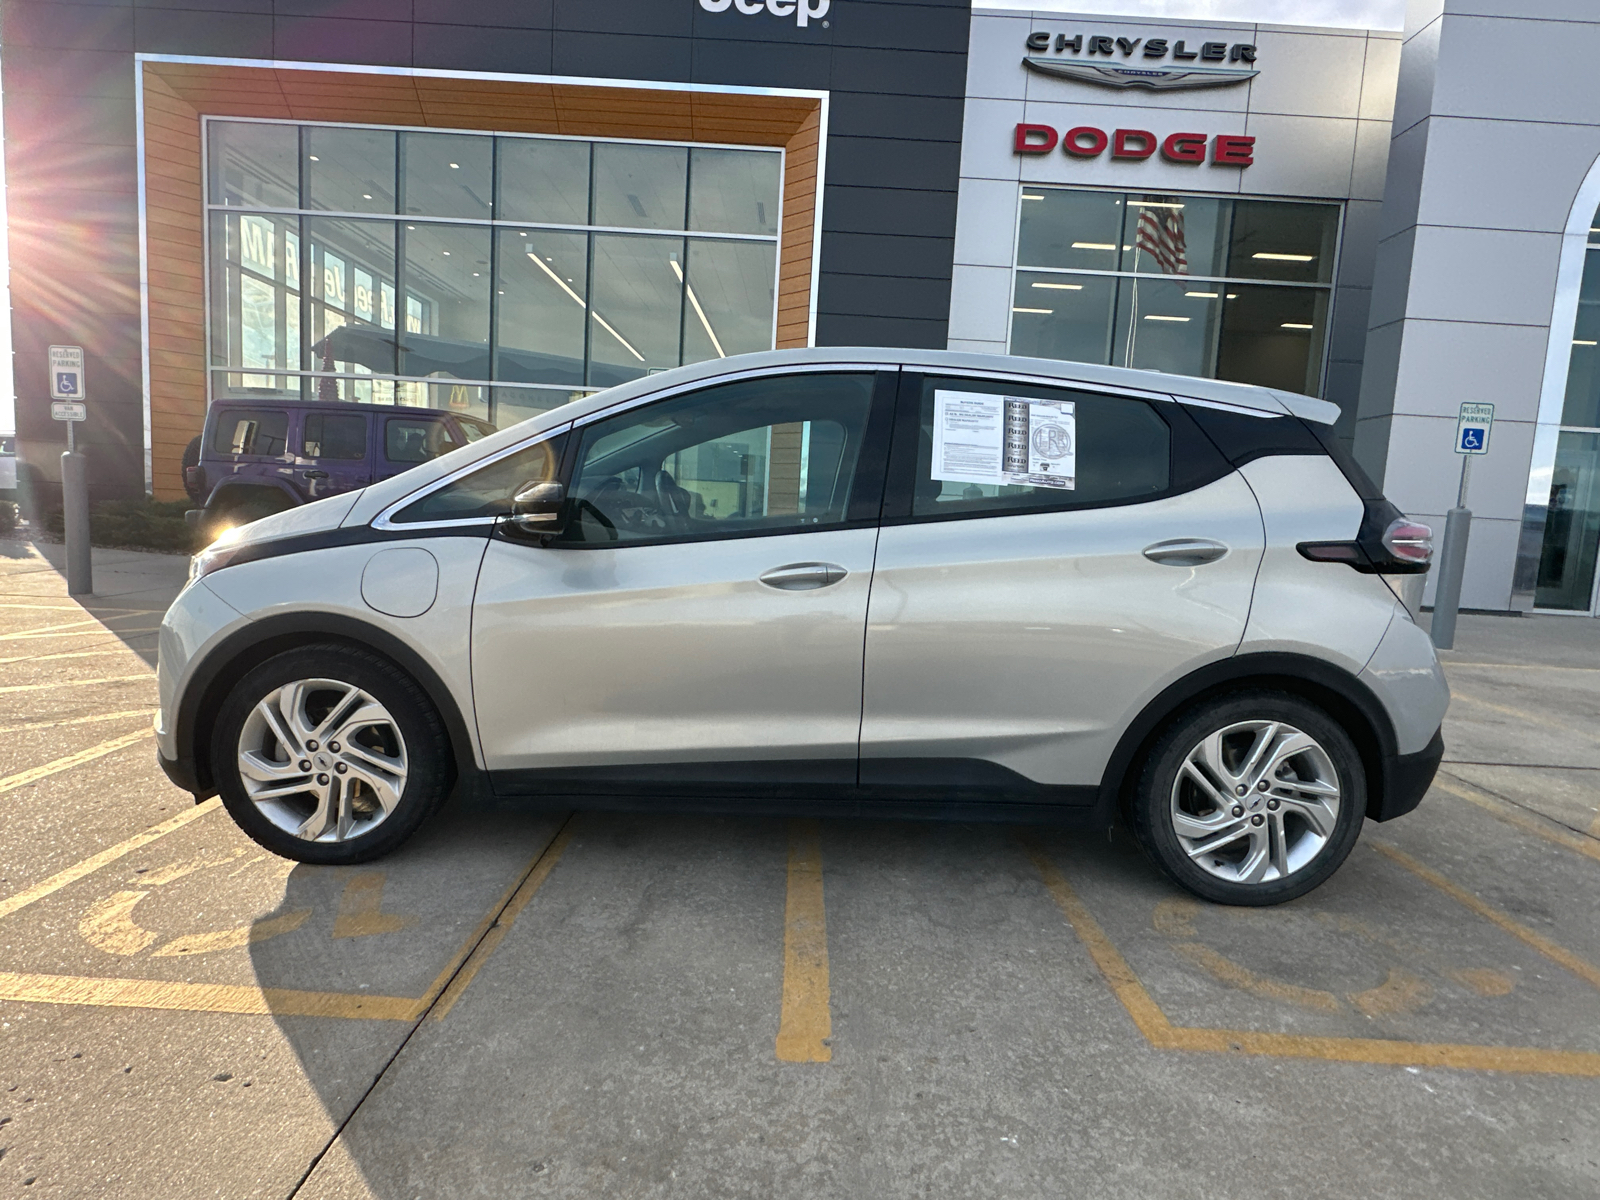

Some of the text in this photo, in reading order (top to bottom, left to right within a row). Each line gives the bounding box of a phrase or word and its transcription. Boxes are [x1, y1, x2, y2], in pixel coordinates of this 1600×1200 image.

[1026, 31, 1257, 62] CHRYSLER
[1117, 69, 1164, 77] CHRYSLER
[1014, 123, 1256, 166] DODGE
[52, 350, 80, 359] RESERVED
[52, 360, 80, 368] PARKING
[1462, 406, 1491, 415] RESERVED
[1461, 415, 1491, 424] PARKING
